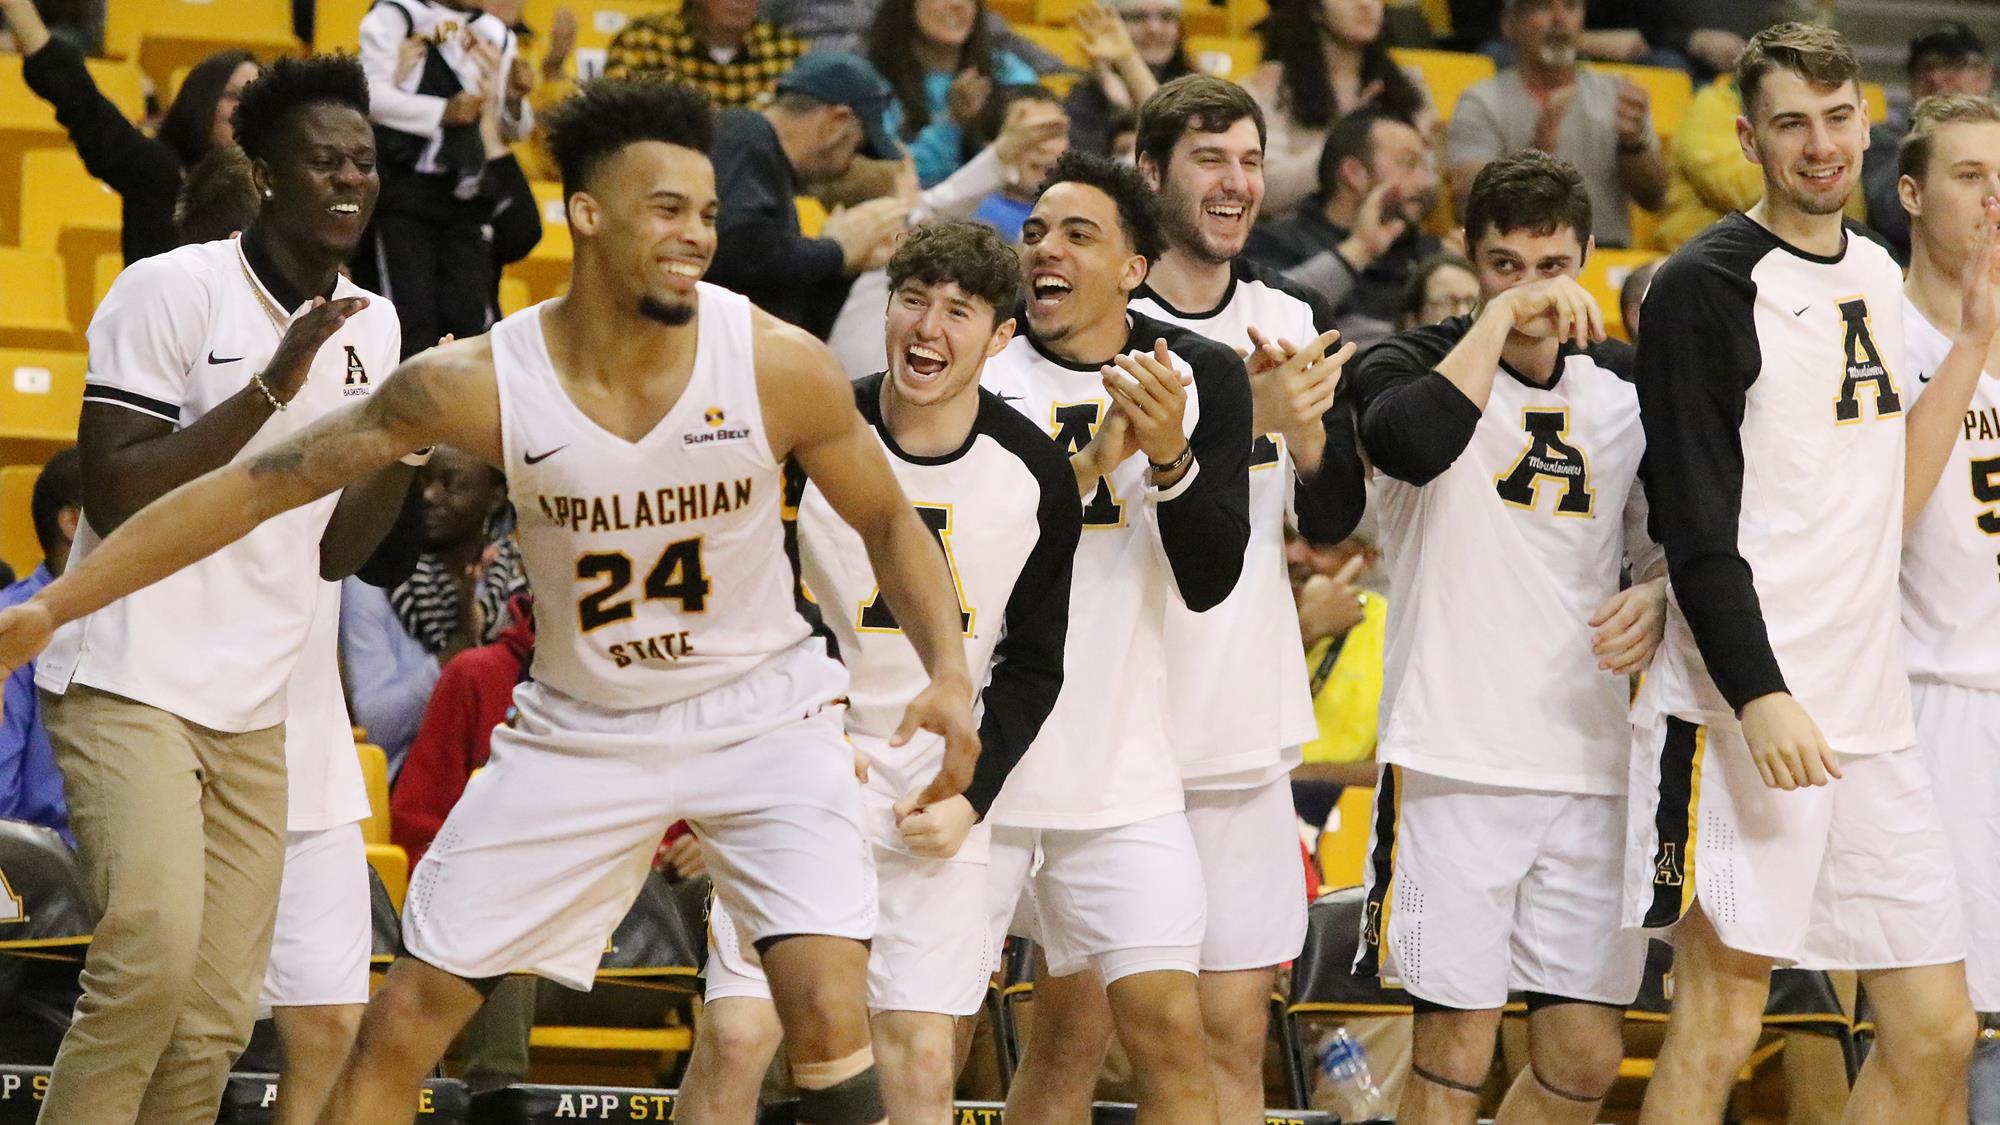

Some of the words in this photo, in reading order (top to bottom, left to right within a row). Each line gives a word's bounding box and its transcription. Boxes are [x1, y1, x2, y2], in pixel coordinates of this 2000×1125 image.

[343, 345, 369, 386] A
[1834, 294, 1904, 426] A
[1493, 406, 1596, 519] A
[538, 477, 752, 533] APPALACHIAN
[576, 535, 713, 635] 24
[608, 630, 694, 668] STATE
[1655, 842, 1683, 886] A
[555, 1093, 620, 1119] APP
